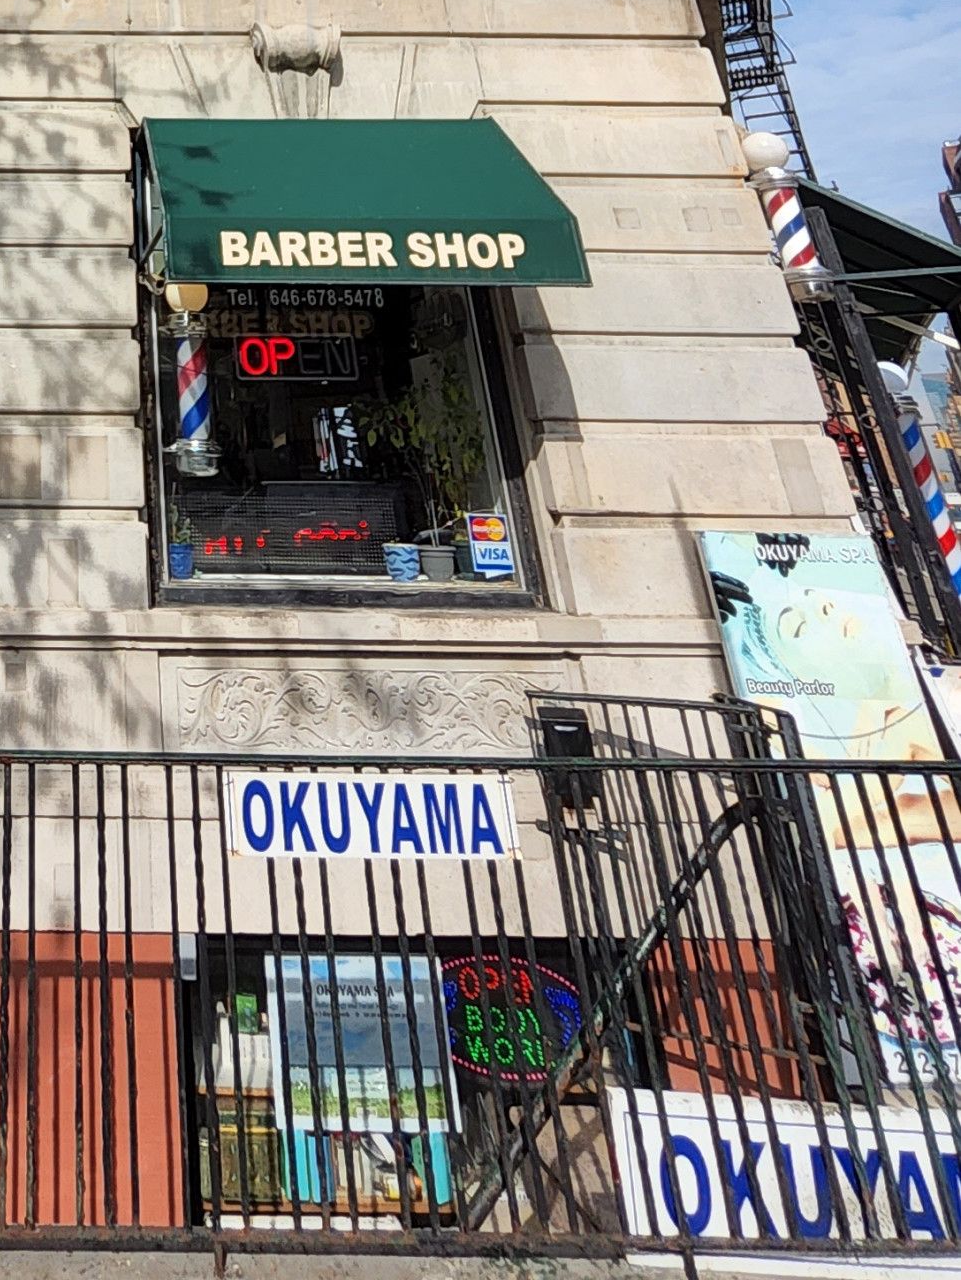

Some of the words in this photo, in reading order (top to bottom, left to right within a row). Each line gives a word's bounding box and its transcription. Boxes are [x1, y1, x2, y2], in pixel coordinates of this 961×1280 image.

[219, 230, 398, 268] BARBER
[406, 231, 526, 269] SHOP
[226, 288, 258, 306] Tel.
[269, 287, 385, 308] 646-678-5478
[239, 337, 351, 376] OPEN
[477, 547, 510, 561] VISA
[754, 543, 838, 564] OKUYAMA
[837, 546, 876, 565] SPA
[745, 678, 795, 698] Beauty
[795, 678, 836, 696] Parlor
[241, 779, 505, 856] OKUYAMA
